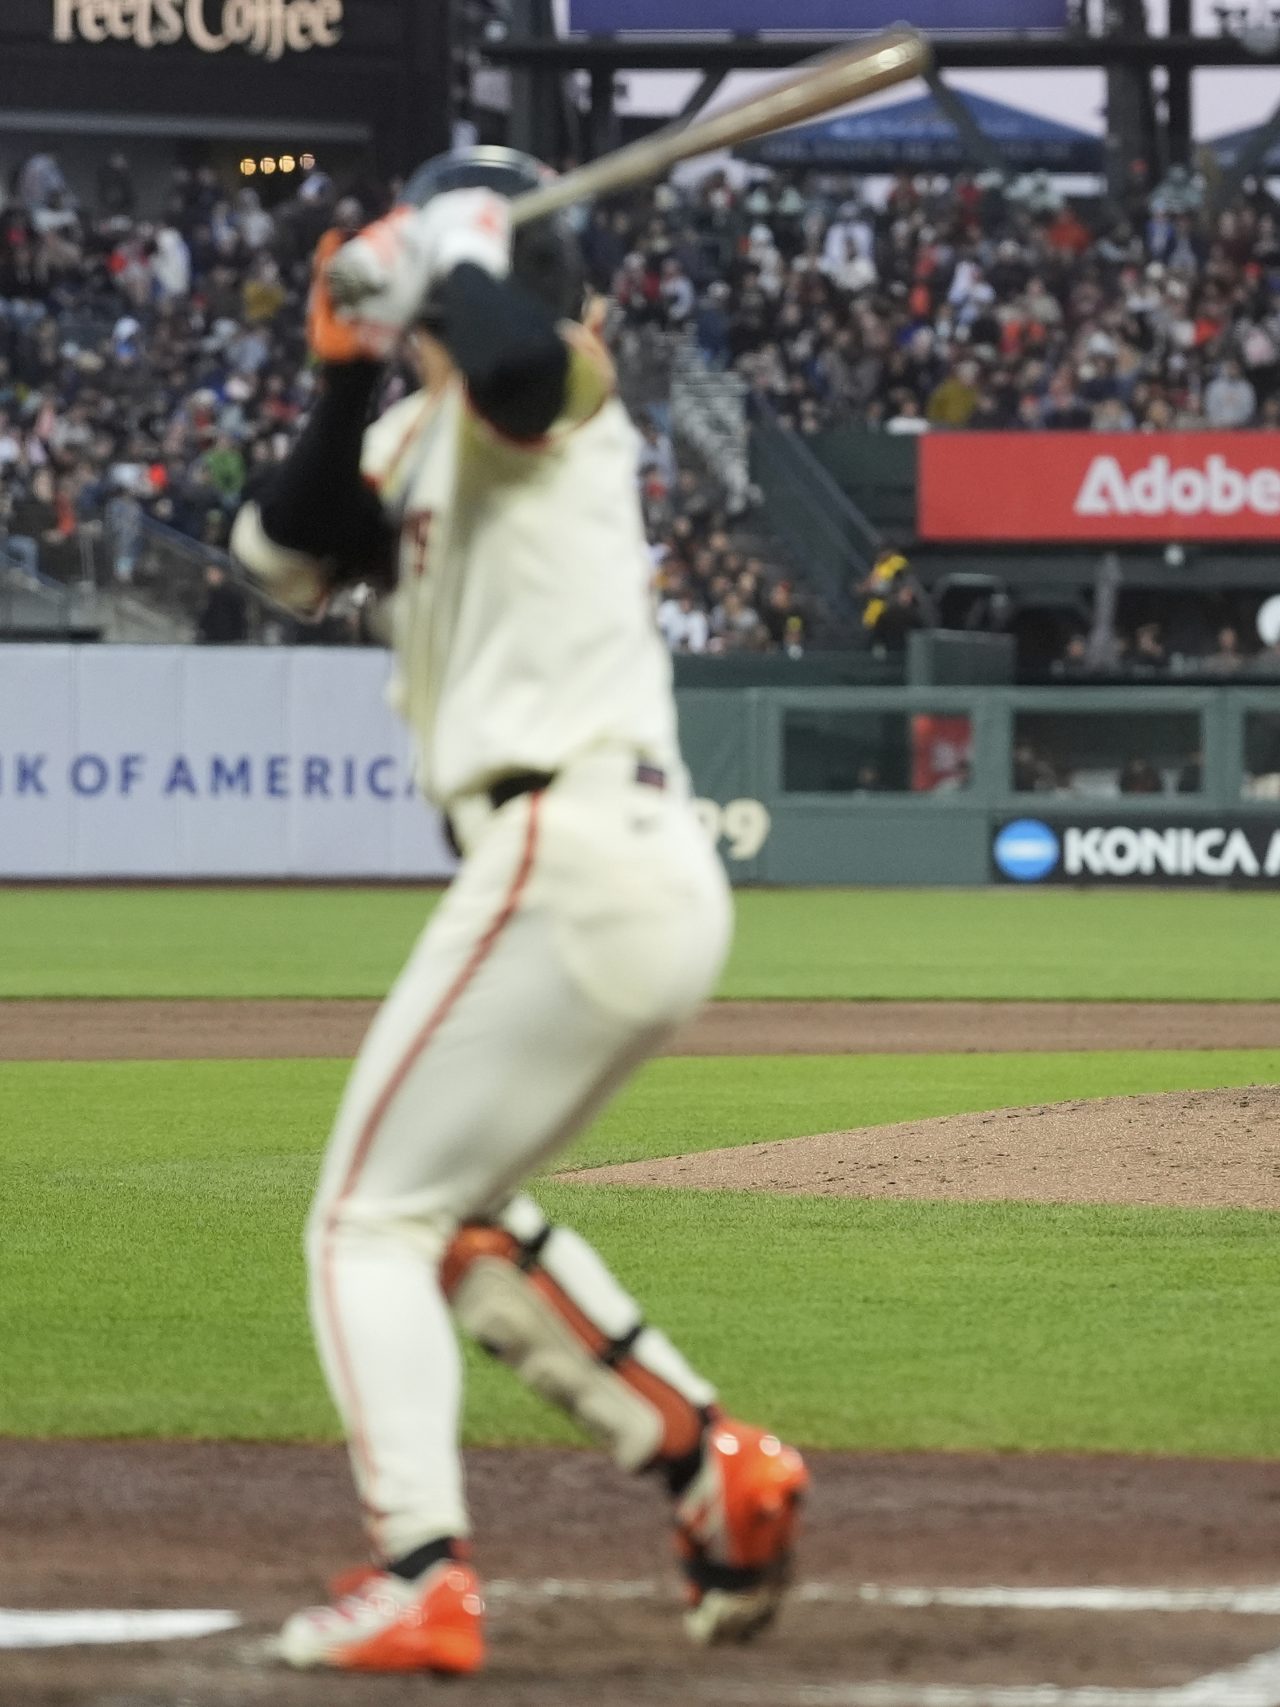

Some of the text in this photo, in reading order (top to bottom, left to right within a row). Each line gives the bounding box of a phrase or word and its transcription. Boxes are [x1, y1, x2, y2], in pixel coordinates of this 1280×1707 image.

[0, 755, 419, 798] K OF AMERIC
[1063, 826, 1259, 876] KONICA
